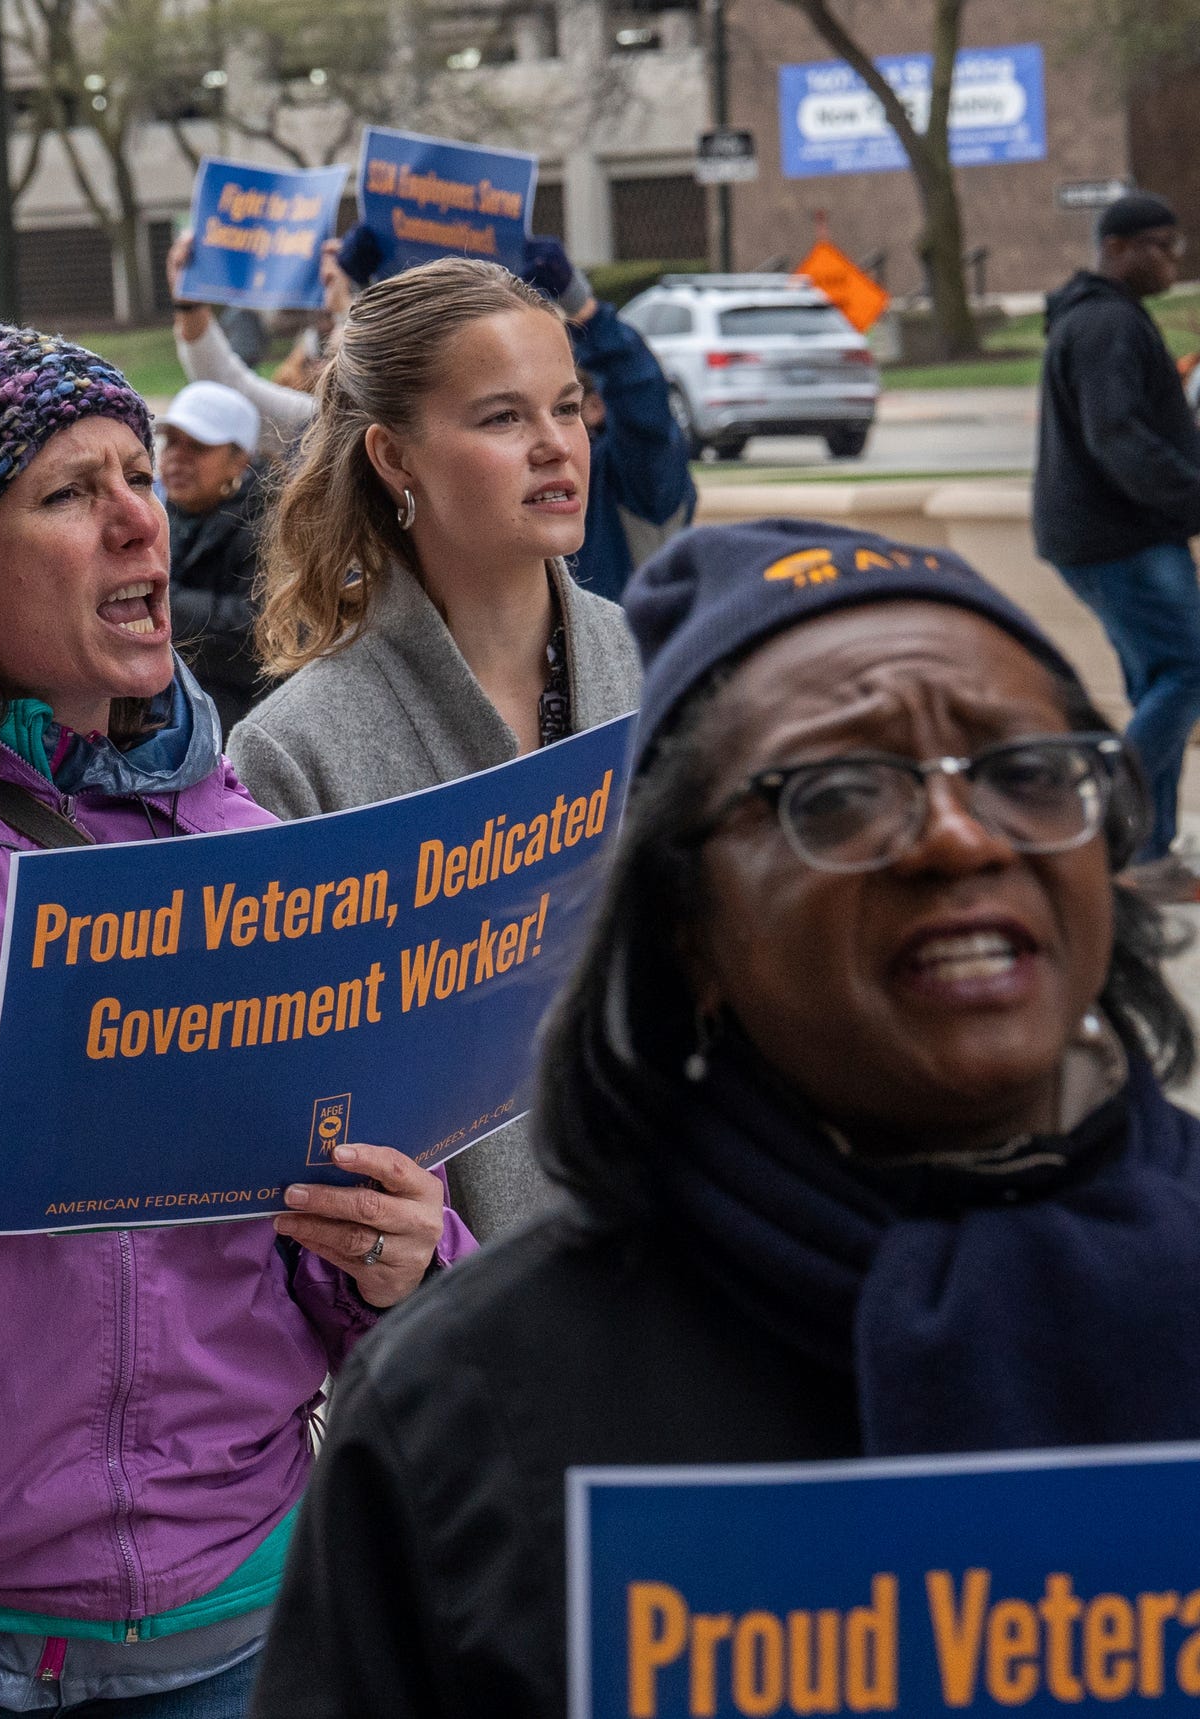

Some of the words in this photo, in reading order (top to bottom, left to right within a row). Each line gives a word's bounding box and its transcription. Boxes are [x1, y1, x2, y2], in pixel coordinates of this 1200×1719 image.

[31, 889, 184, 968] Proud
[202, 869, 399, 951] Veteran,
[414, 769, 614, 908] Dedicated
[86, 962, 385, 1060] Government
[400, 893, 550, 1012] Worker!
[320, 1104, 344, 1118] AFGE
[468, 1098, 515, 1132] AFL-CIO
[45, 1197, 140, 1215] AMERICAN
[144, 1190, 252, 1207] FEDERATION
[257, 1187, 281, 1200] OF
[626, 1569, 899, 1719] Proud
